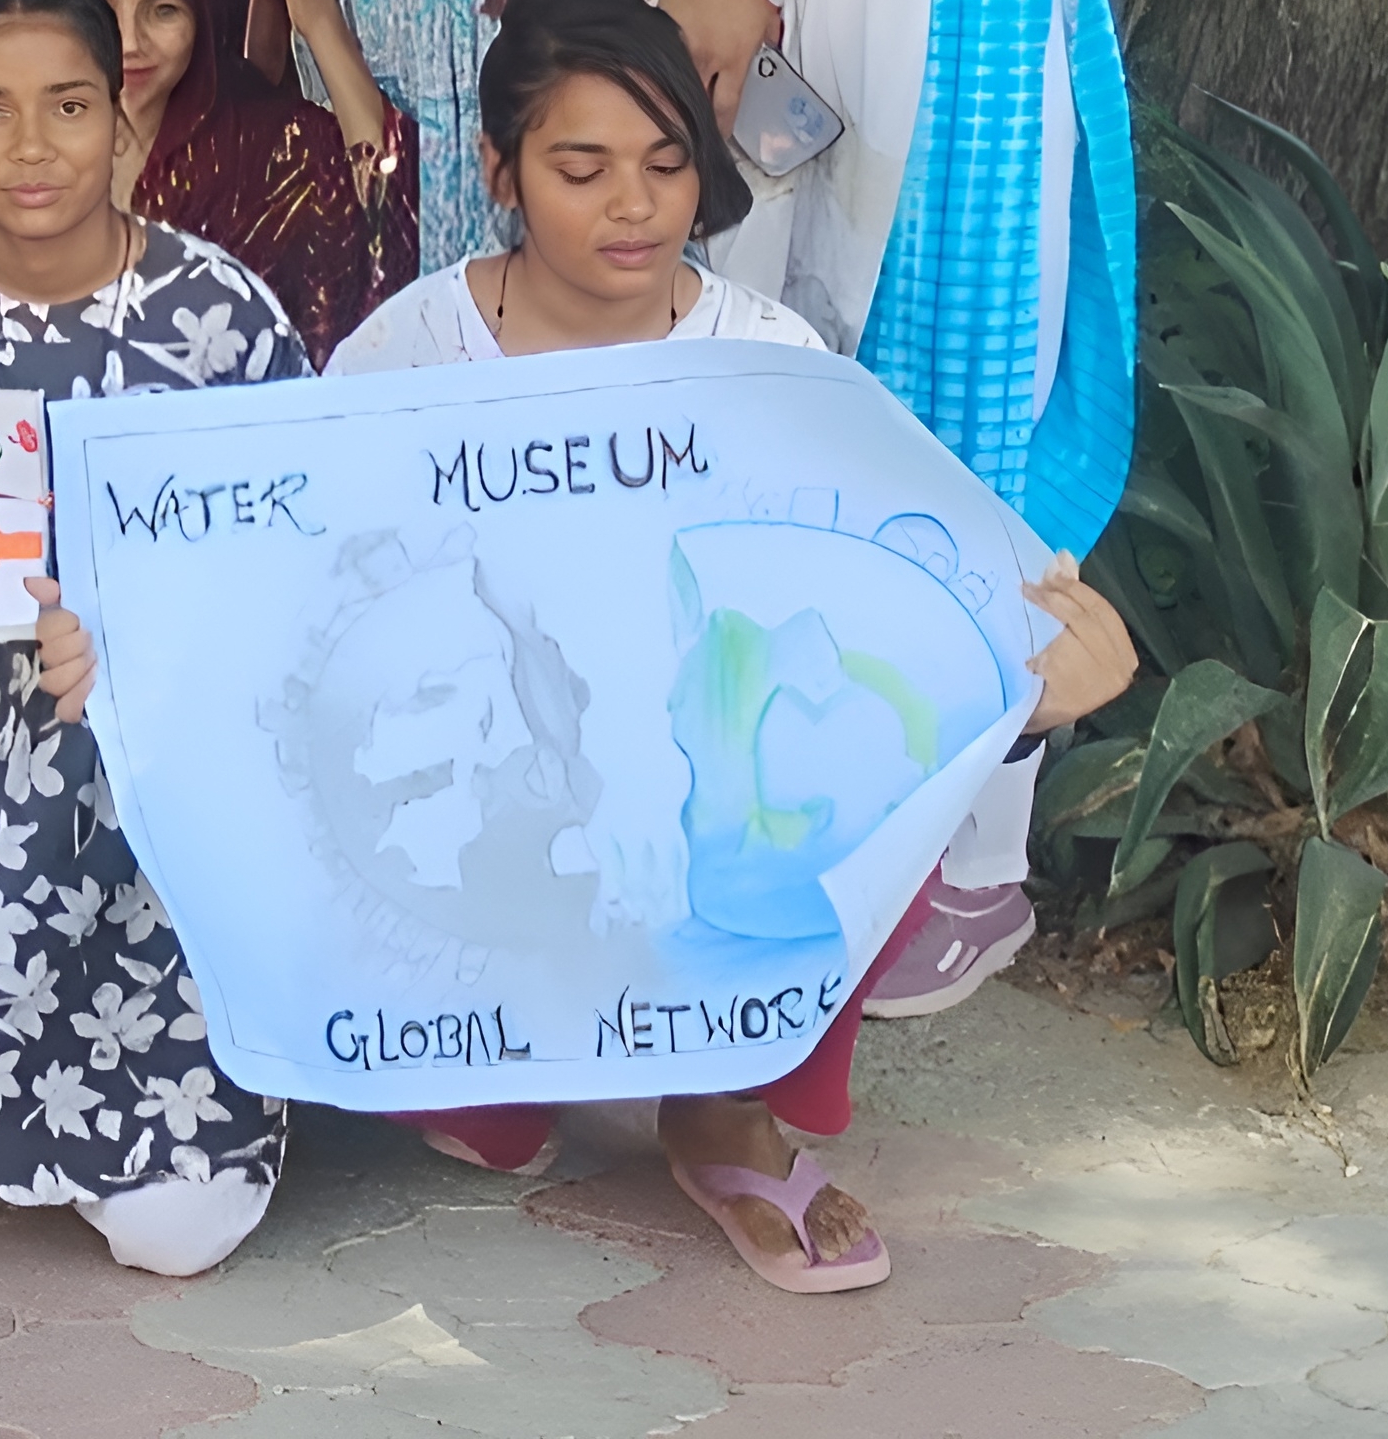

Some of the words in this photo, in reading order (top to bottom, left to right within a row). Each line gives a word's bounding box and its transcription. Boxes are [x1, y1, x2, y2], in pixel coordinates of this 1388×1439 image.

[105, 474, 326, 543] WATER
[423, 422, 709, 513] MUSEUM
[326, 1001, 533, 1071] GLOBAL
